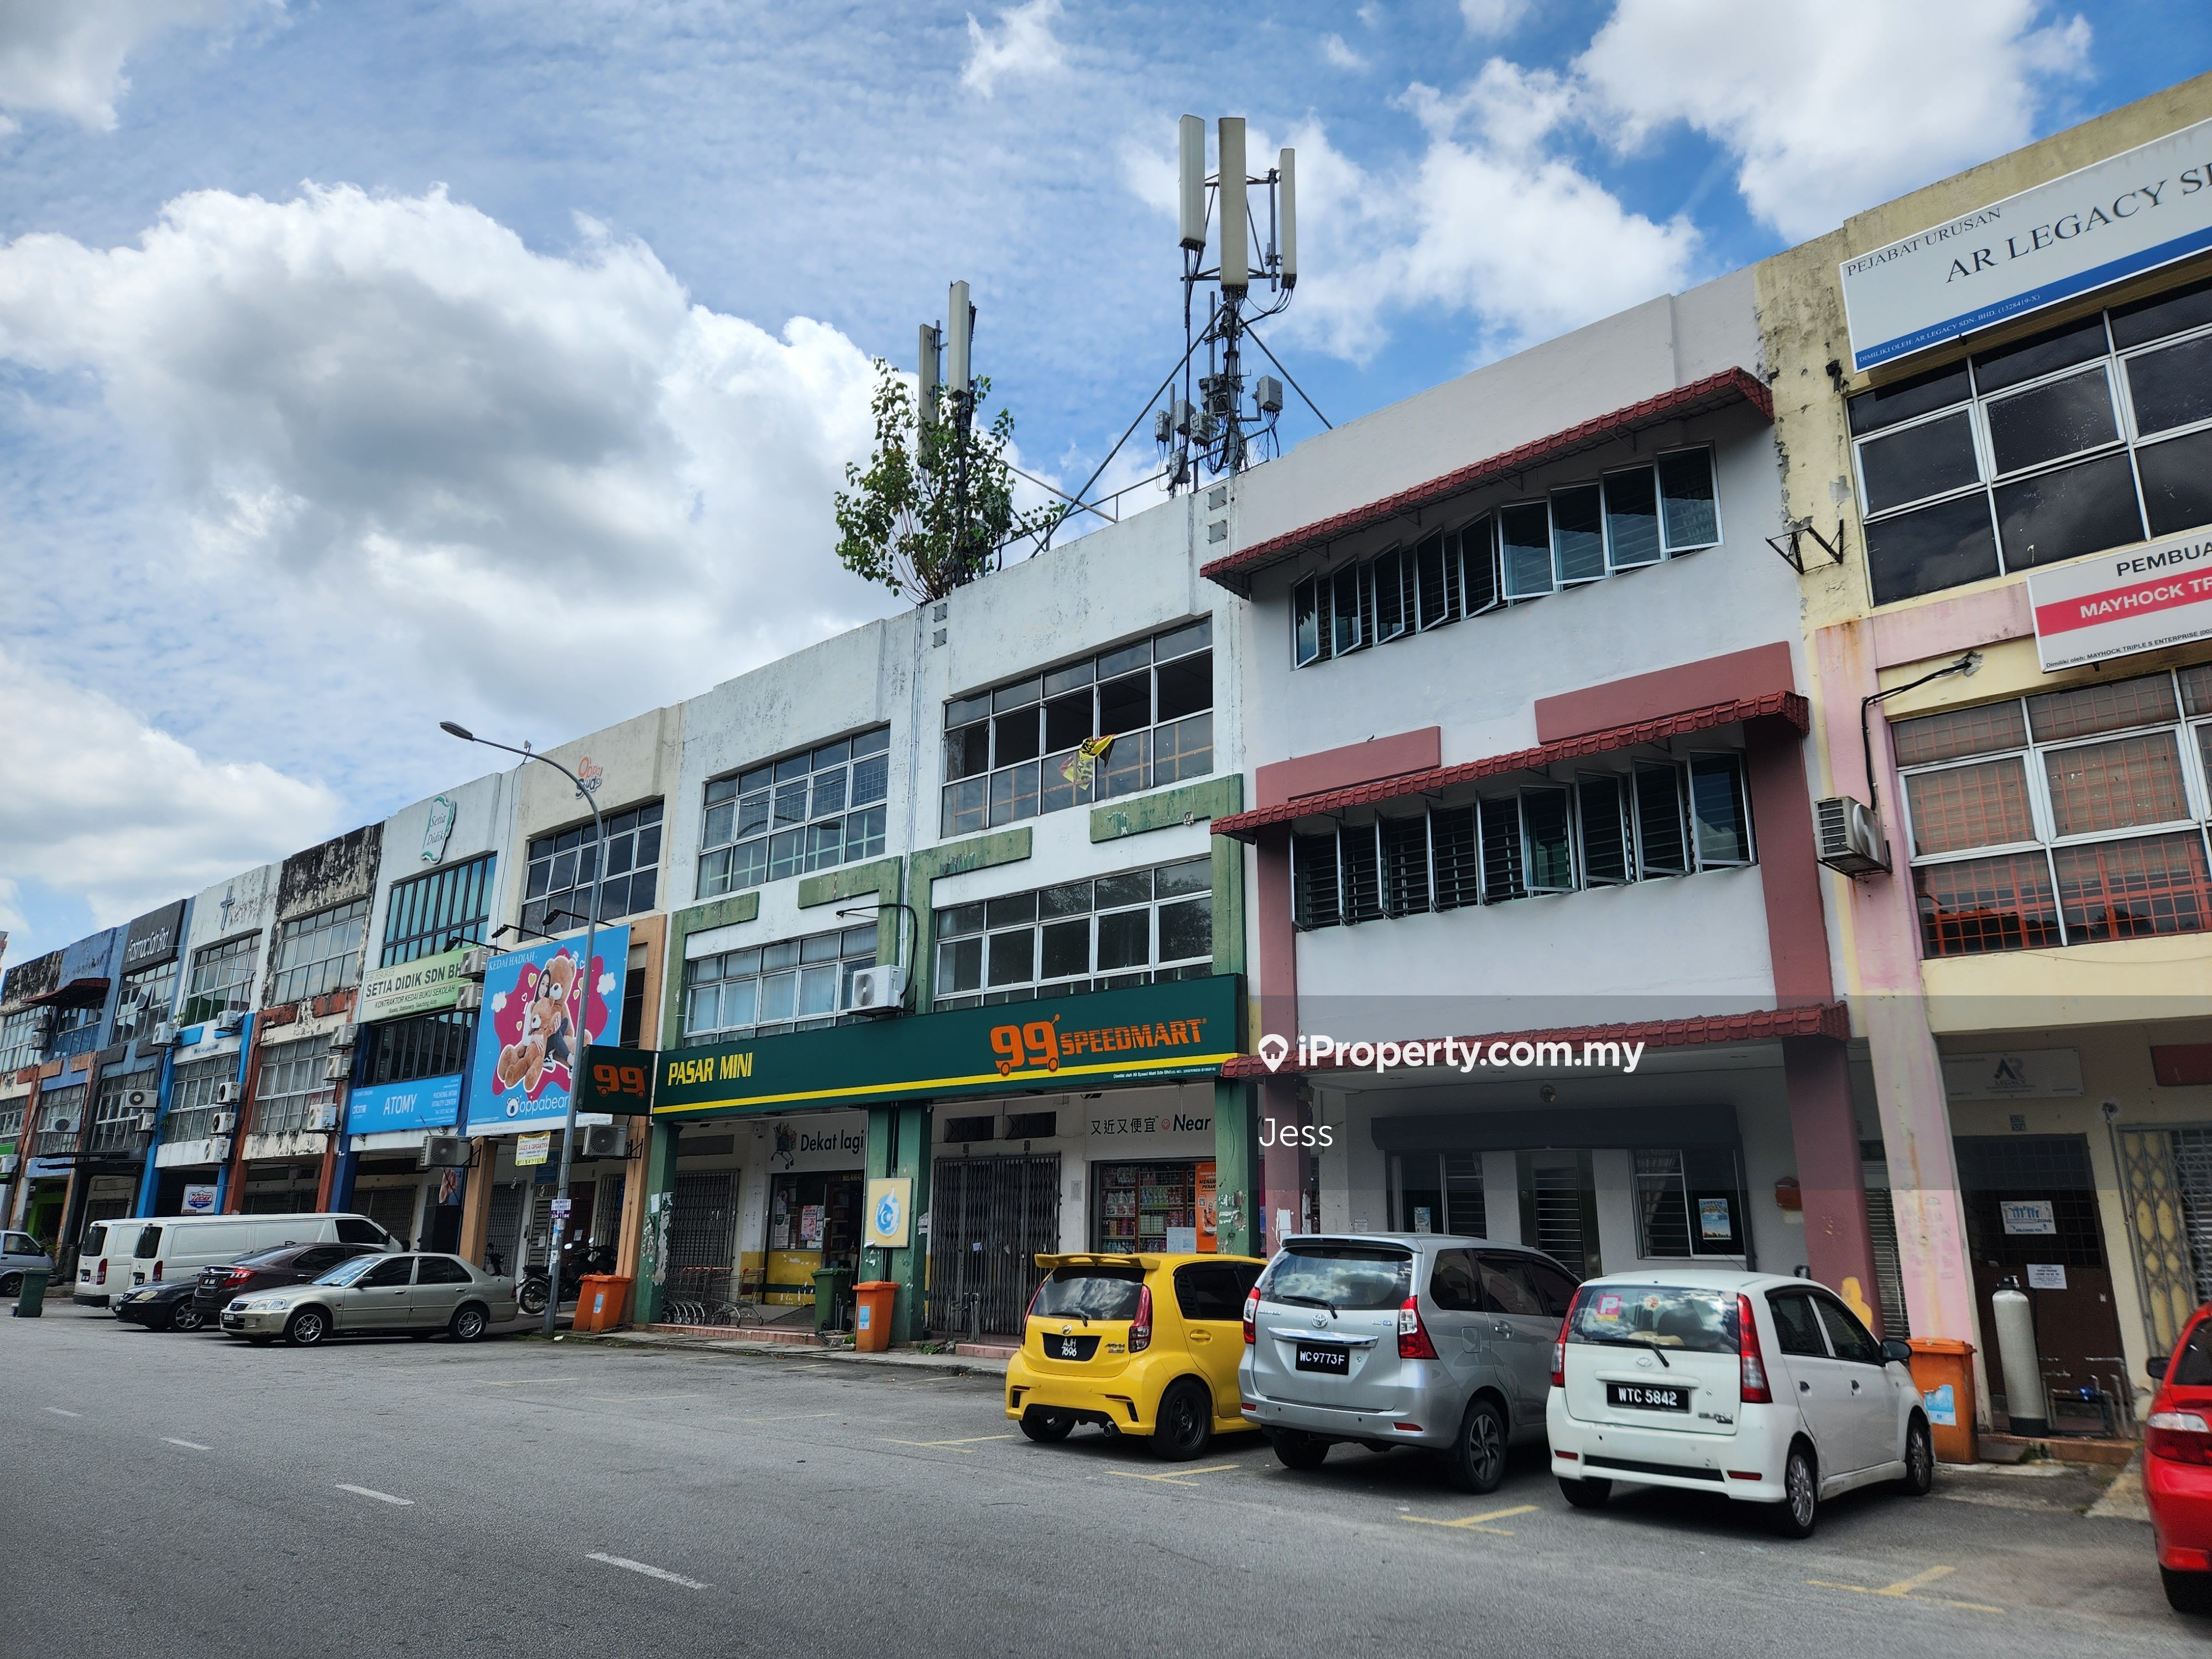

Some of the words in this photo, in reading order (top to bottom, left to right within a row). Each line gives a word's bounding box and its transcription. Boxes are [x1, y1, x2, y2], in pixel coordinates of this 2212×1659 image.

[1847, 239, 1921, 276] PEJABAT
[1926, 207, 2001, 246] URUSAN
[1946, 248, 1999, 283] AR
[2005, 179, 2168, 260] LEGACY
[1859, 347, 1890, 362] DIMILIKI
[1891, 340, 1914, 351] OLEH:
[1914, 335, 1926, 343] AR
[1927, 323, 1958, 338] LEGACY
[1959, 317, 1976, 327] SDN.
[1978, 311, 1997, 320] BHD.
[1998, 294, 2040, 314] (1328419-X)
[2080, 583, 2185, 619] MAYHOCK
[2046, 659, 2069, 668] Dimiliki
[2087, 648, 2121, 659] MAYHOCK
[2122, 642, 2147, 652] TRIPLE
[2154, 631, 2198, 645] ENTERPRISE
[430, 813, 446, 827] Setia
[426, 830, 444, 846] Didik
[488, 957, 508, 971] KEDAI
[509, 951, 535, 966] HADIAH
[366, 979, 392, 998] SETIA
[395, 972, 423, 990] DIDIK
[424, 966, 445, 984] SDN
[374, 995, 404, 1009] KONTRAKTOR
[405, 993, 419, 1002] KEDAI
[419, 990, 432, 1000] BUKU
[432, 985, 455, 997] SEKOLAH
[990, 1016, 1060, 1076] 99
[1060, 1019, 1204, 1056] SPEEDMART
[667, 1057, 714, 1086] PASAR
[719, 1052, 753, 1080] MINI
[593, 1064, 647, 1098] 99
[383, 1093, 418, 1115] ATOMY
[519, 1094, 568, 1115] oppabear
[1091, 1117, 1156, 1135] 又近又便宜
[1173, 1114, 1211, 1131] Near
[801, 1130, 837, 1151] Dekat
[841, 1129, 865, 1155] lagi
[1600, 1297, 1618, 1314] P
[1061, 1346, 1077, 1357] 7696
[1063, 1337, 1077, 1348] AJH
[1300, 1350, 1345, 1366] WC9773F
[1618, 1386, 1642, 1403] WTC
[1645, 1389, 1677, 1406] 5842
